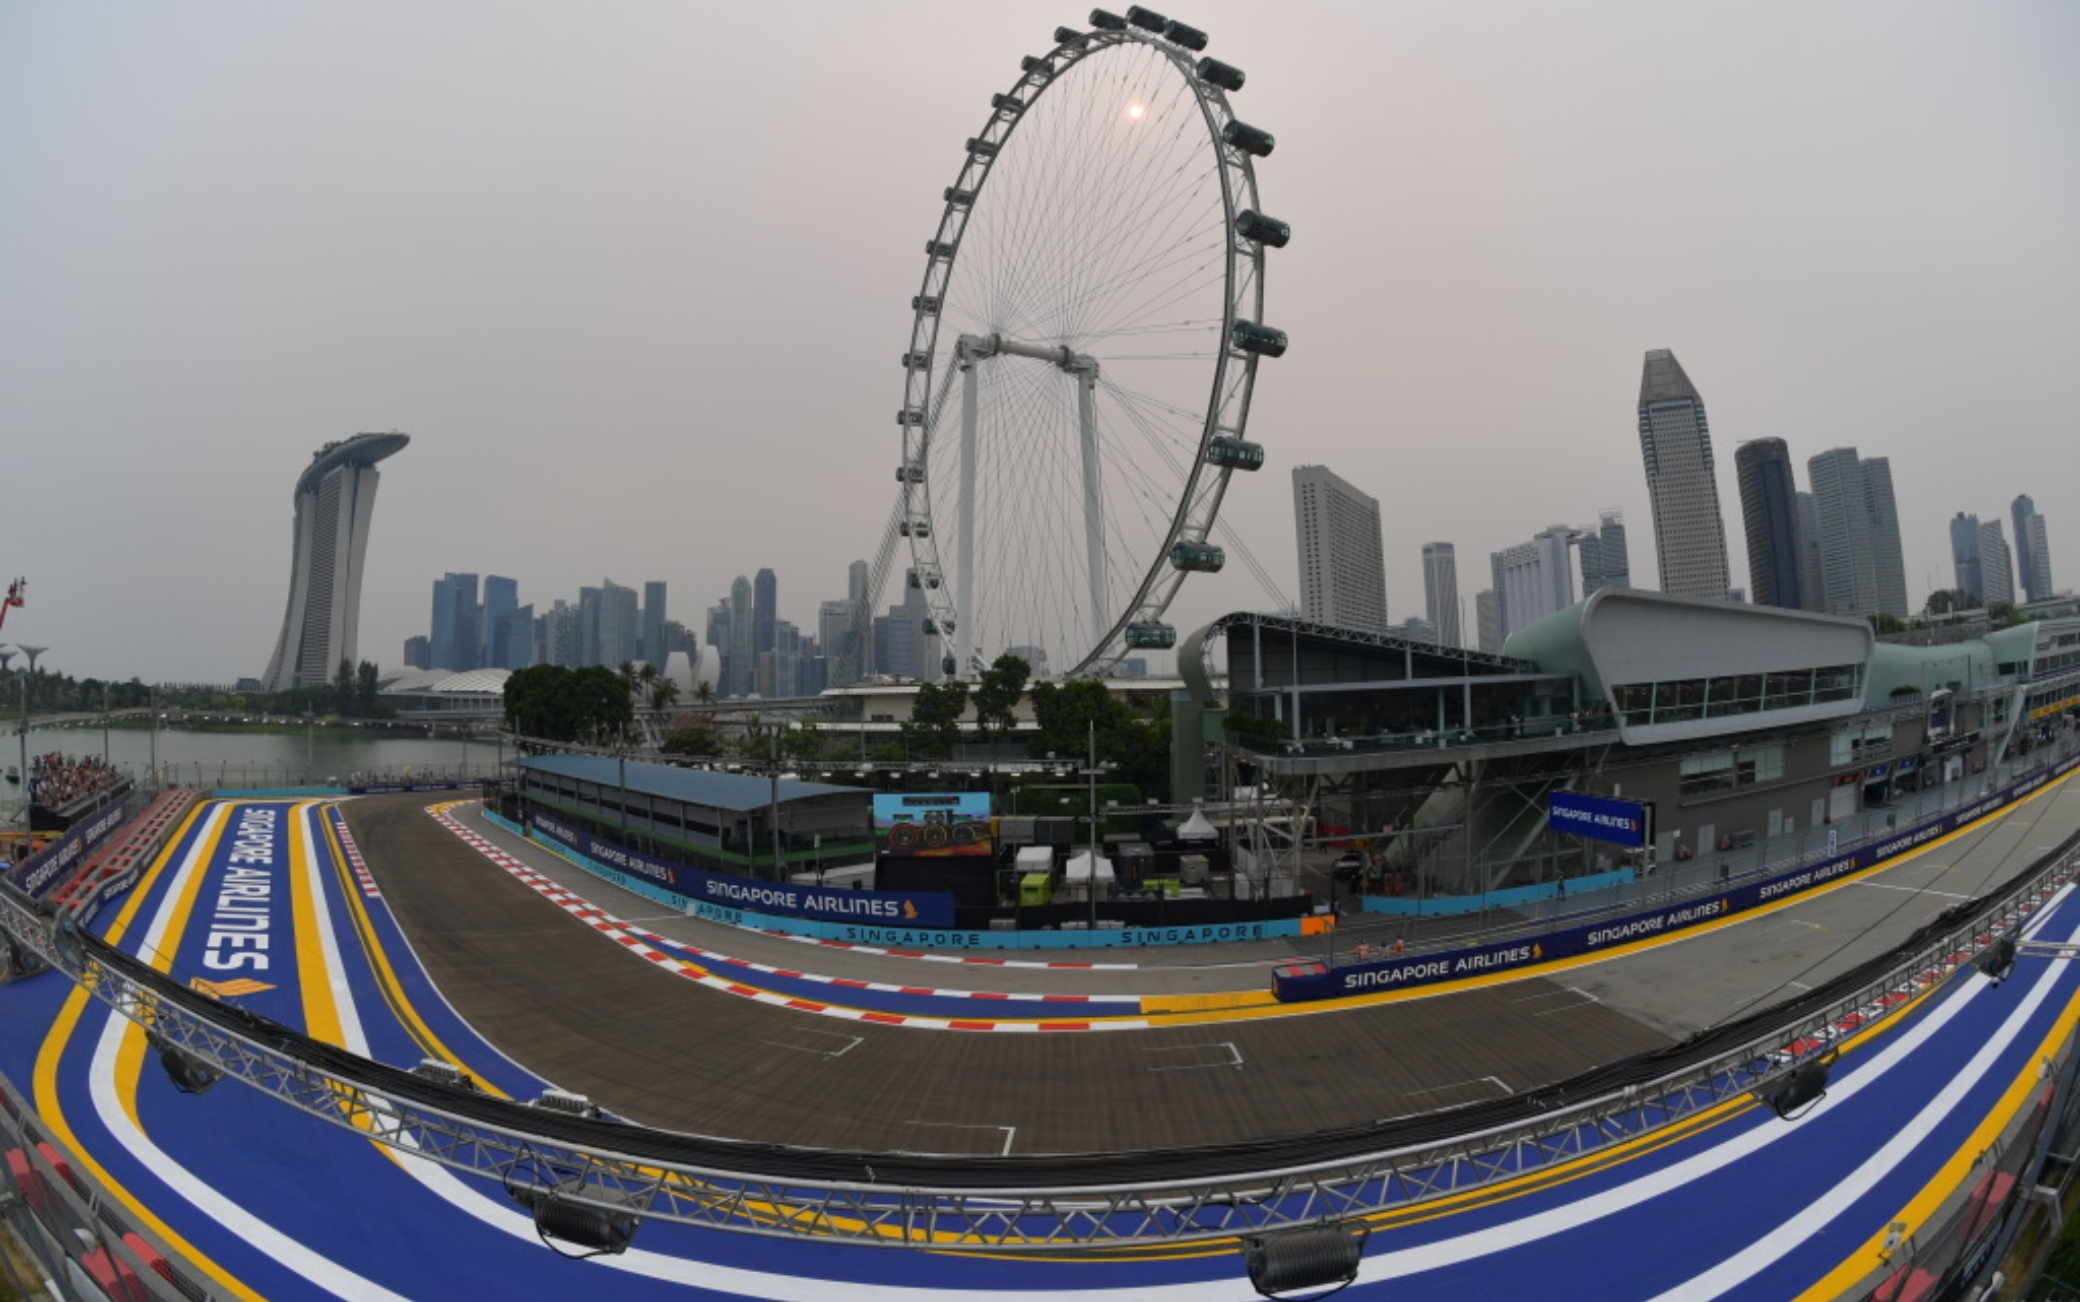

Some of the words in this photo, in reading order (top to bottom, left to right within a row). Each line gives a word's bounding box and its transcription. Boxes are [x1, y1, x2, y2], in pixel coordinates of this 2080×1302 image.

[229, 808, 276, 864] SINGAPORE
[590, 842, 627, 867] SINGAPORE
[628, 857, 667, 881] AIRLINES
[1759, 872, 1812, 899] SINGAPORE
[1813, 859, 1850, 880] AIRLINES
[203, 866, 272, 970] AIRLINES
[706, 879, 797, 908] SINGAPORE
[804, 894, 899, 917] AIRLINES
[846, 927, 981, 946] SINGAPORE
[1121, 923, 1264, 944] SINGAPORE
[1588, 915, 1664, 945] SINGAPORE
[1667, 901, 1720, 926] AIRLINES
[1345, 960, 1449, 988] SINGAPORE
[1455, 946, 1530, 972] AIRLINES
